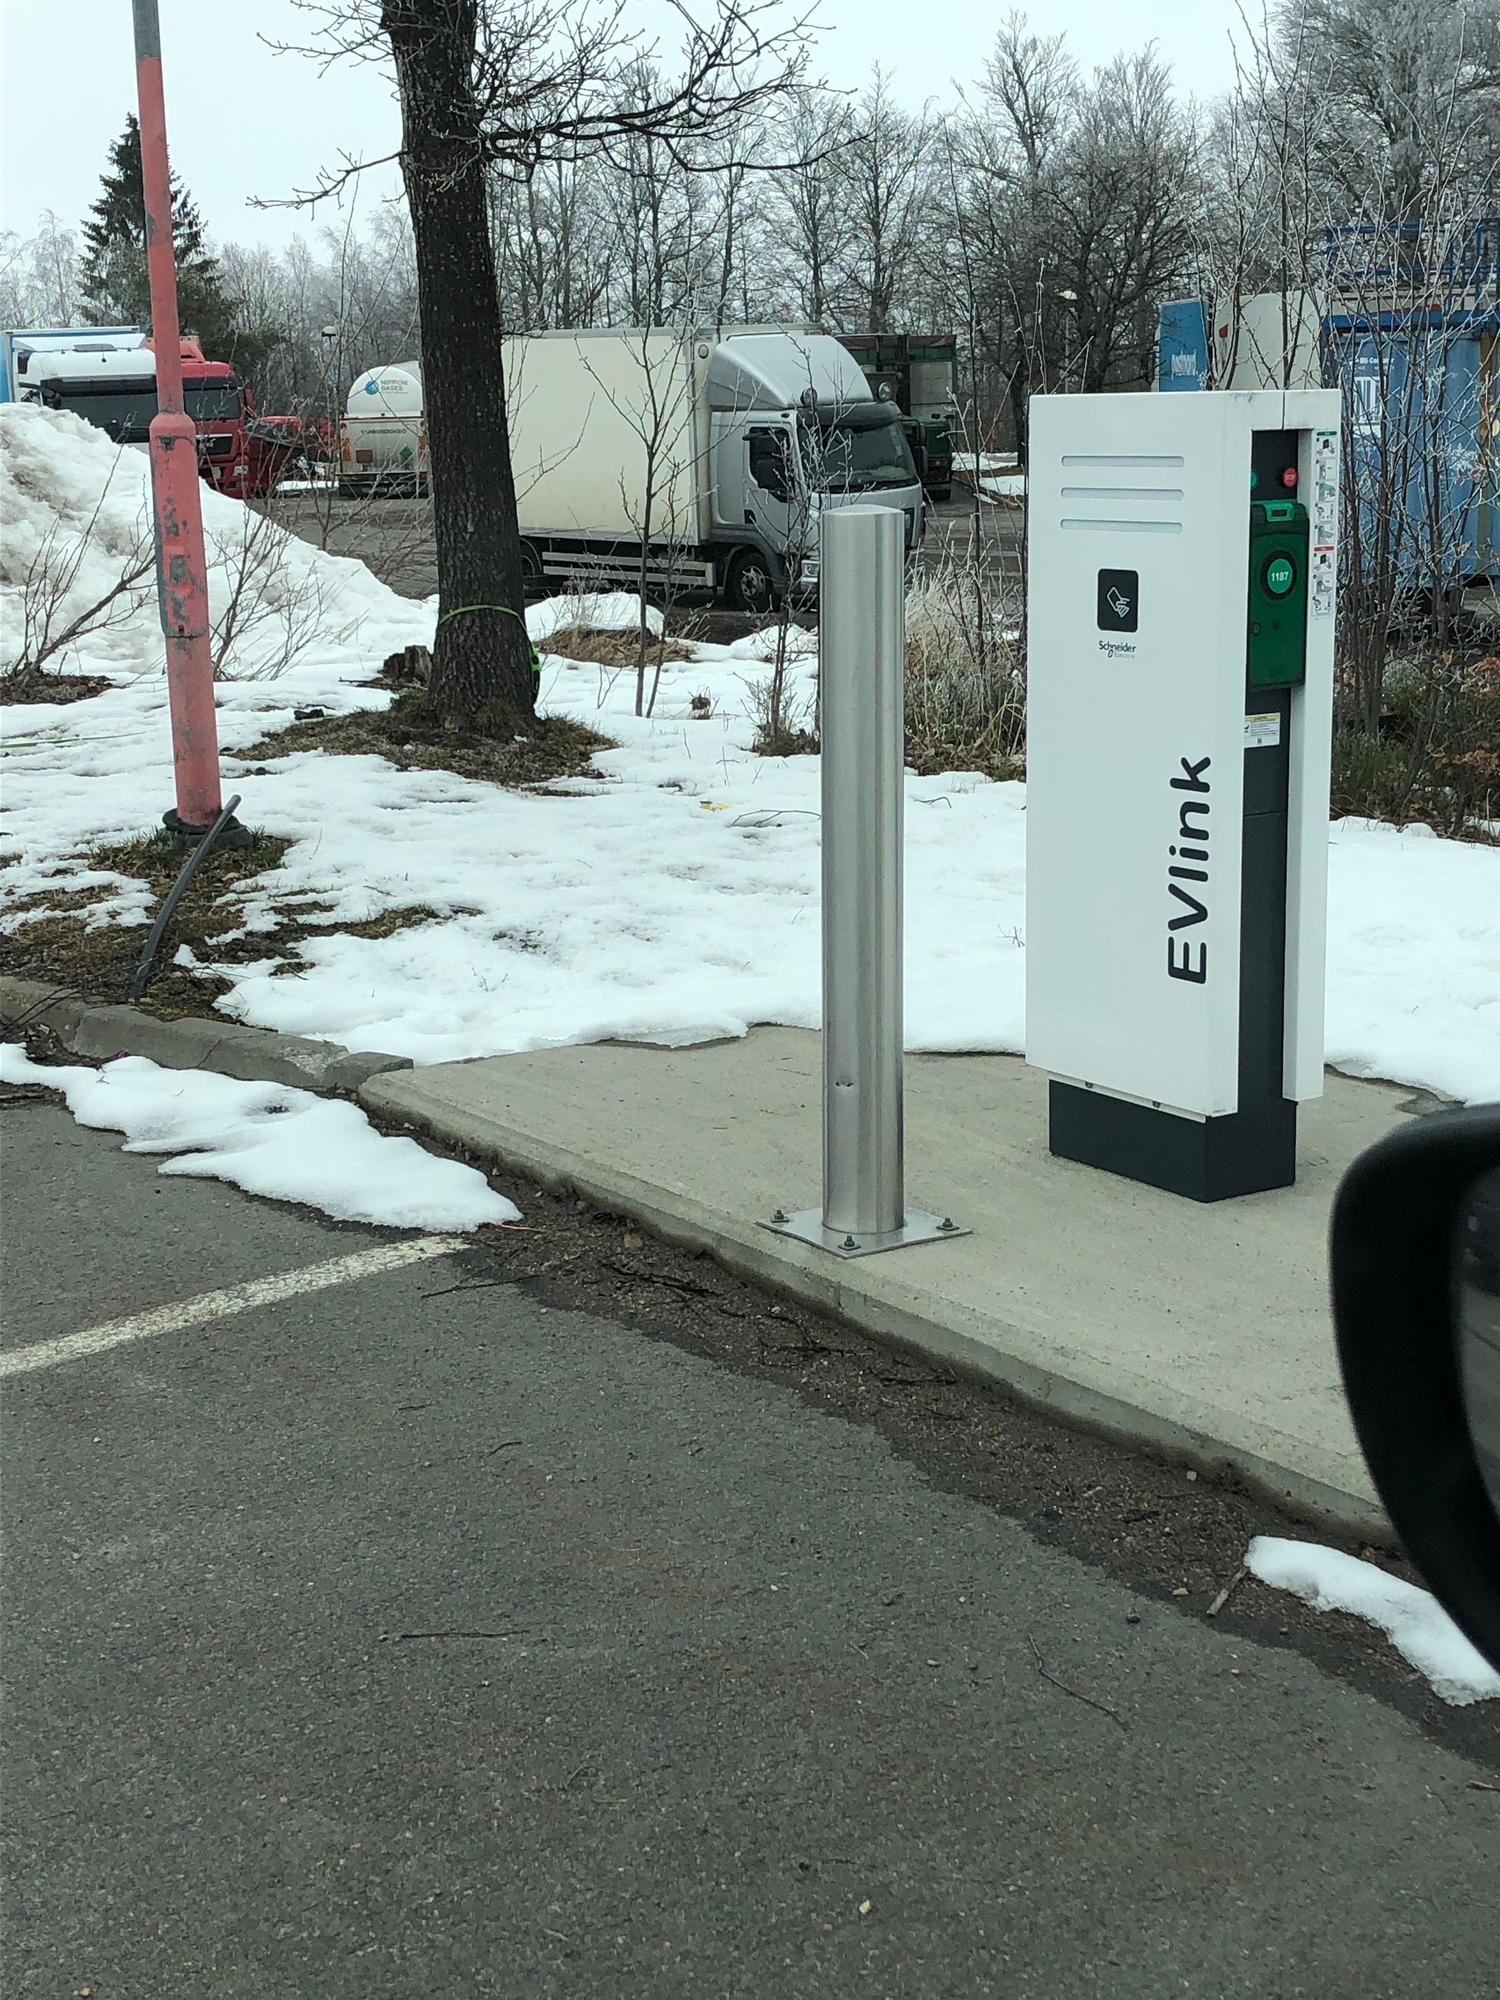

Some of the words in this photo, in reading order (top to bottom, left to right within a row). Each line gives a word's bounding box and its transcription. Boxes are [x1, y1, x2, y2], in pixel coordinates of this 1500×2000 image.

[1271, 571, 1289, 582] 1187
[1098, 640, 1137, 653] Schneider
[1167, 756, 1211, 984] EVlink
